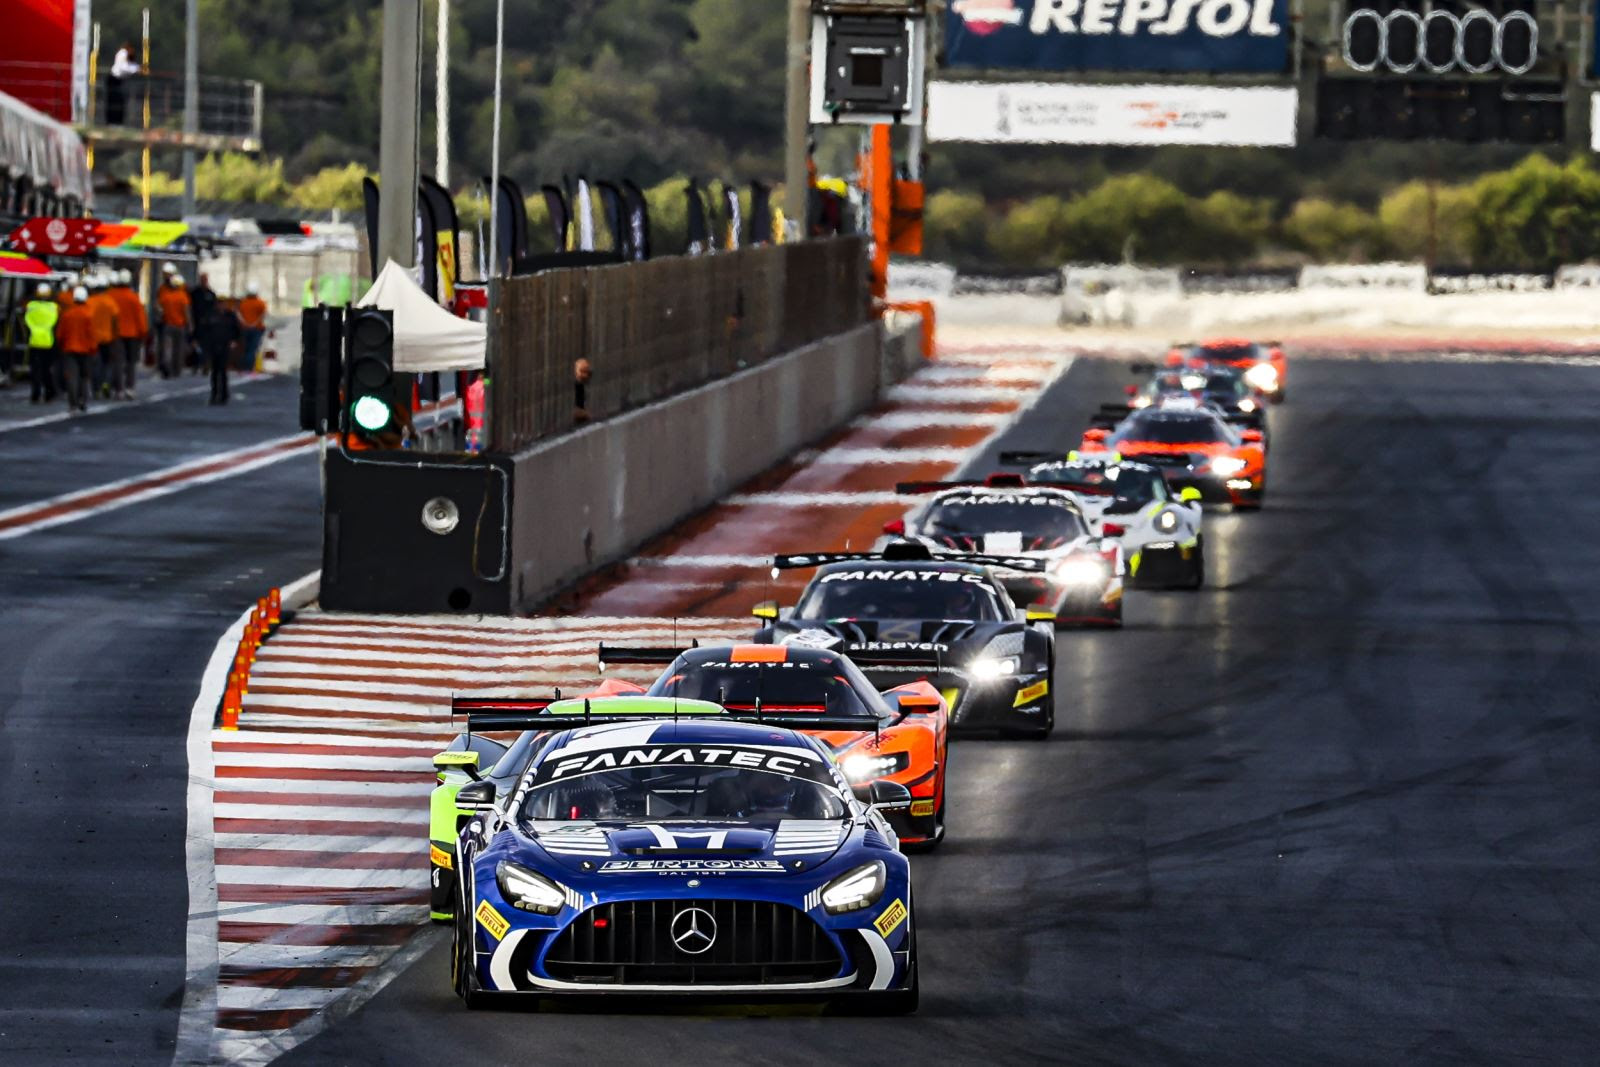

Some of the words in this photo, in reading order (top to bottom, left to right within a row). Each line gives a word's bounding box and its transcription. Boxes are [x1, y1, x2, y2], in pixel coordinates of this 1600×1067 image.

[1029, 0, 1281, 36] REPSOL
[820, 570, 983, 584] FANATEC
[551, 749, 805, 779] FANATEC
[478, 904, 506, 936] PIRELLI
[877, 903, 904, 934] PIRELLI
